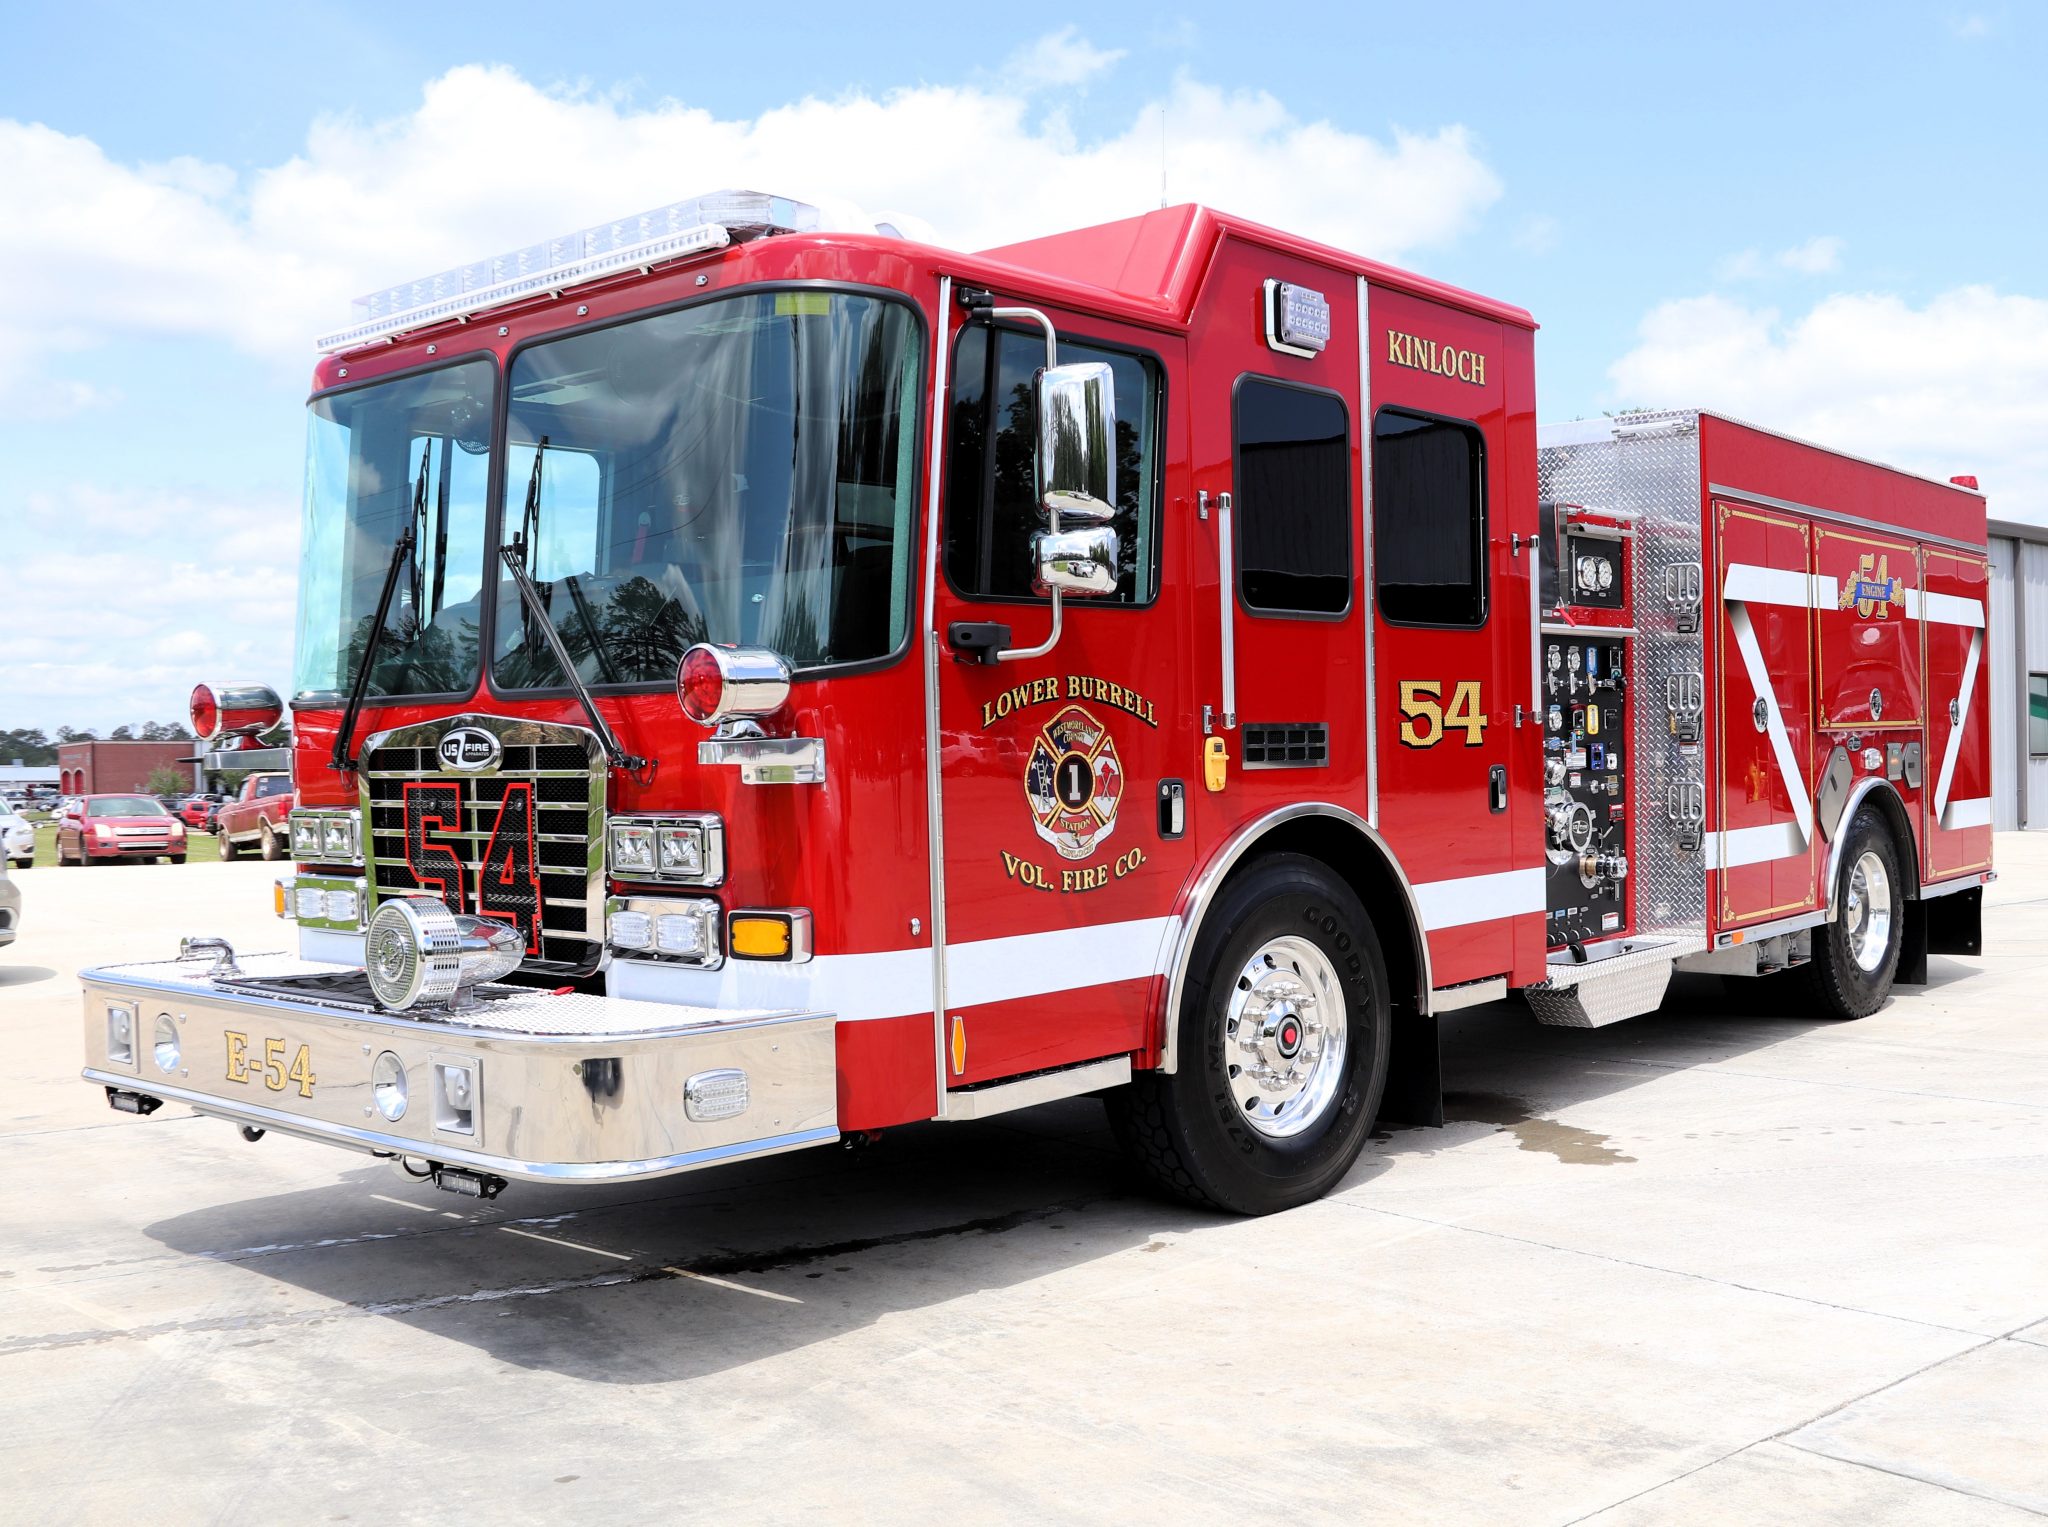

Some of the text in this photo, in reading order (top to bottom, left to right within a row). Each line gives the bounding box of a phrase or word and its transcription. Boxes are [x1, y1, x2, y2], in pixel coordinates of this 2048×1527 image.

[1386, 328, 1486, 387] KINLOCH
[1857, 552, 1888, 619] 54
[1861, 583, 1887, 598] ENGINE
[981, 674, 1159, 730] LOWER BURRELL
[1398, 679, 1488, 749] 54
[444, 742, 490, 757] US FIRE
[1068, 764, 1082, 801] 1
[1060, 816, 1091, 832] STATION
[403, 781, 542, 956] 54
[1001, 846, 1148, 893] VOL. FIRE CO.
[224, 1030, 317, 1099] E-54
